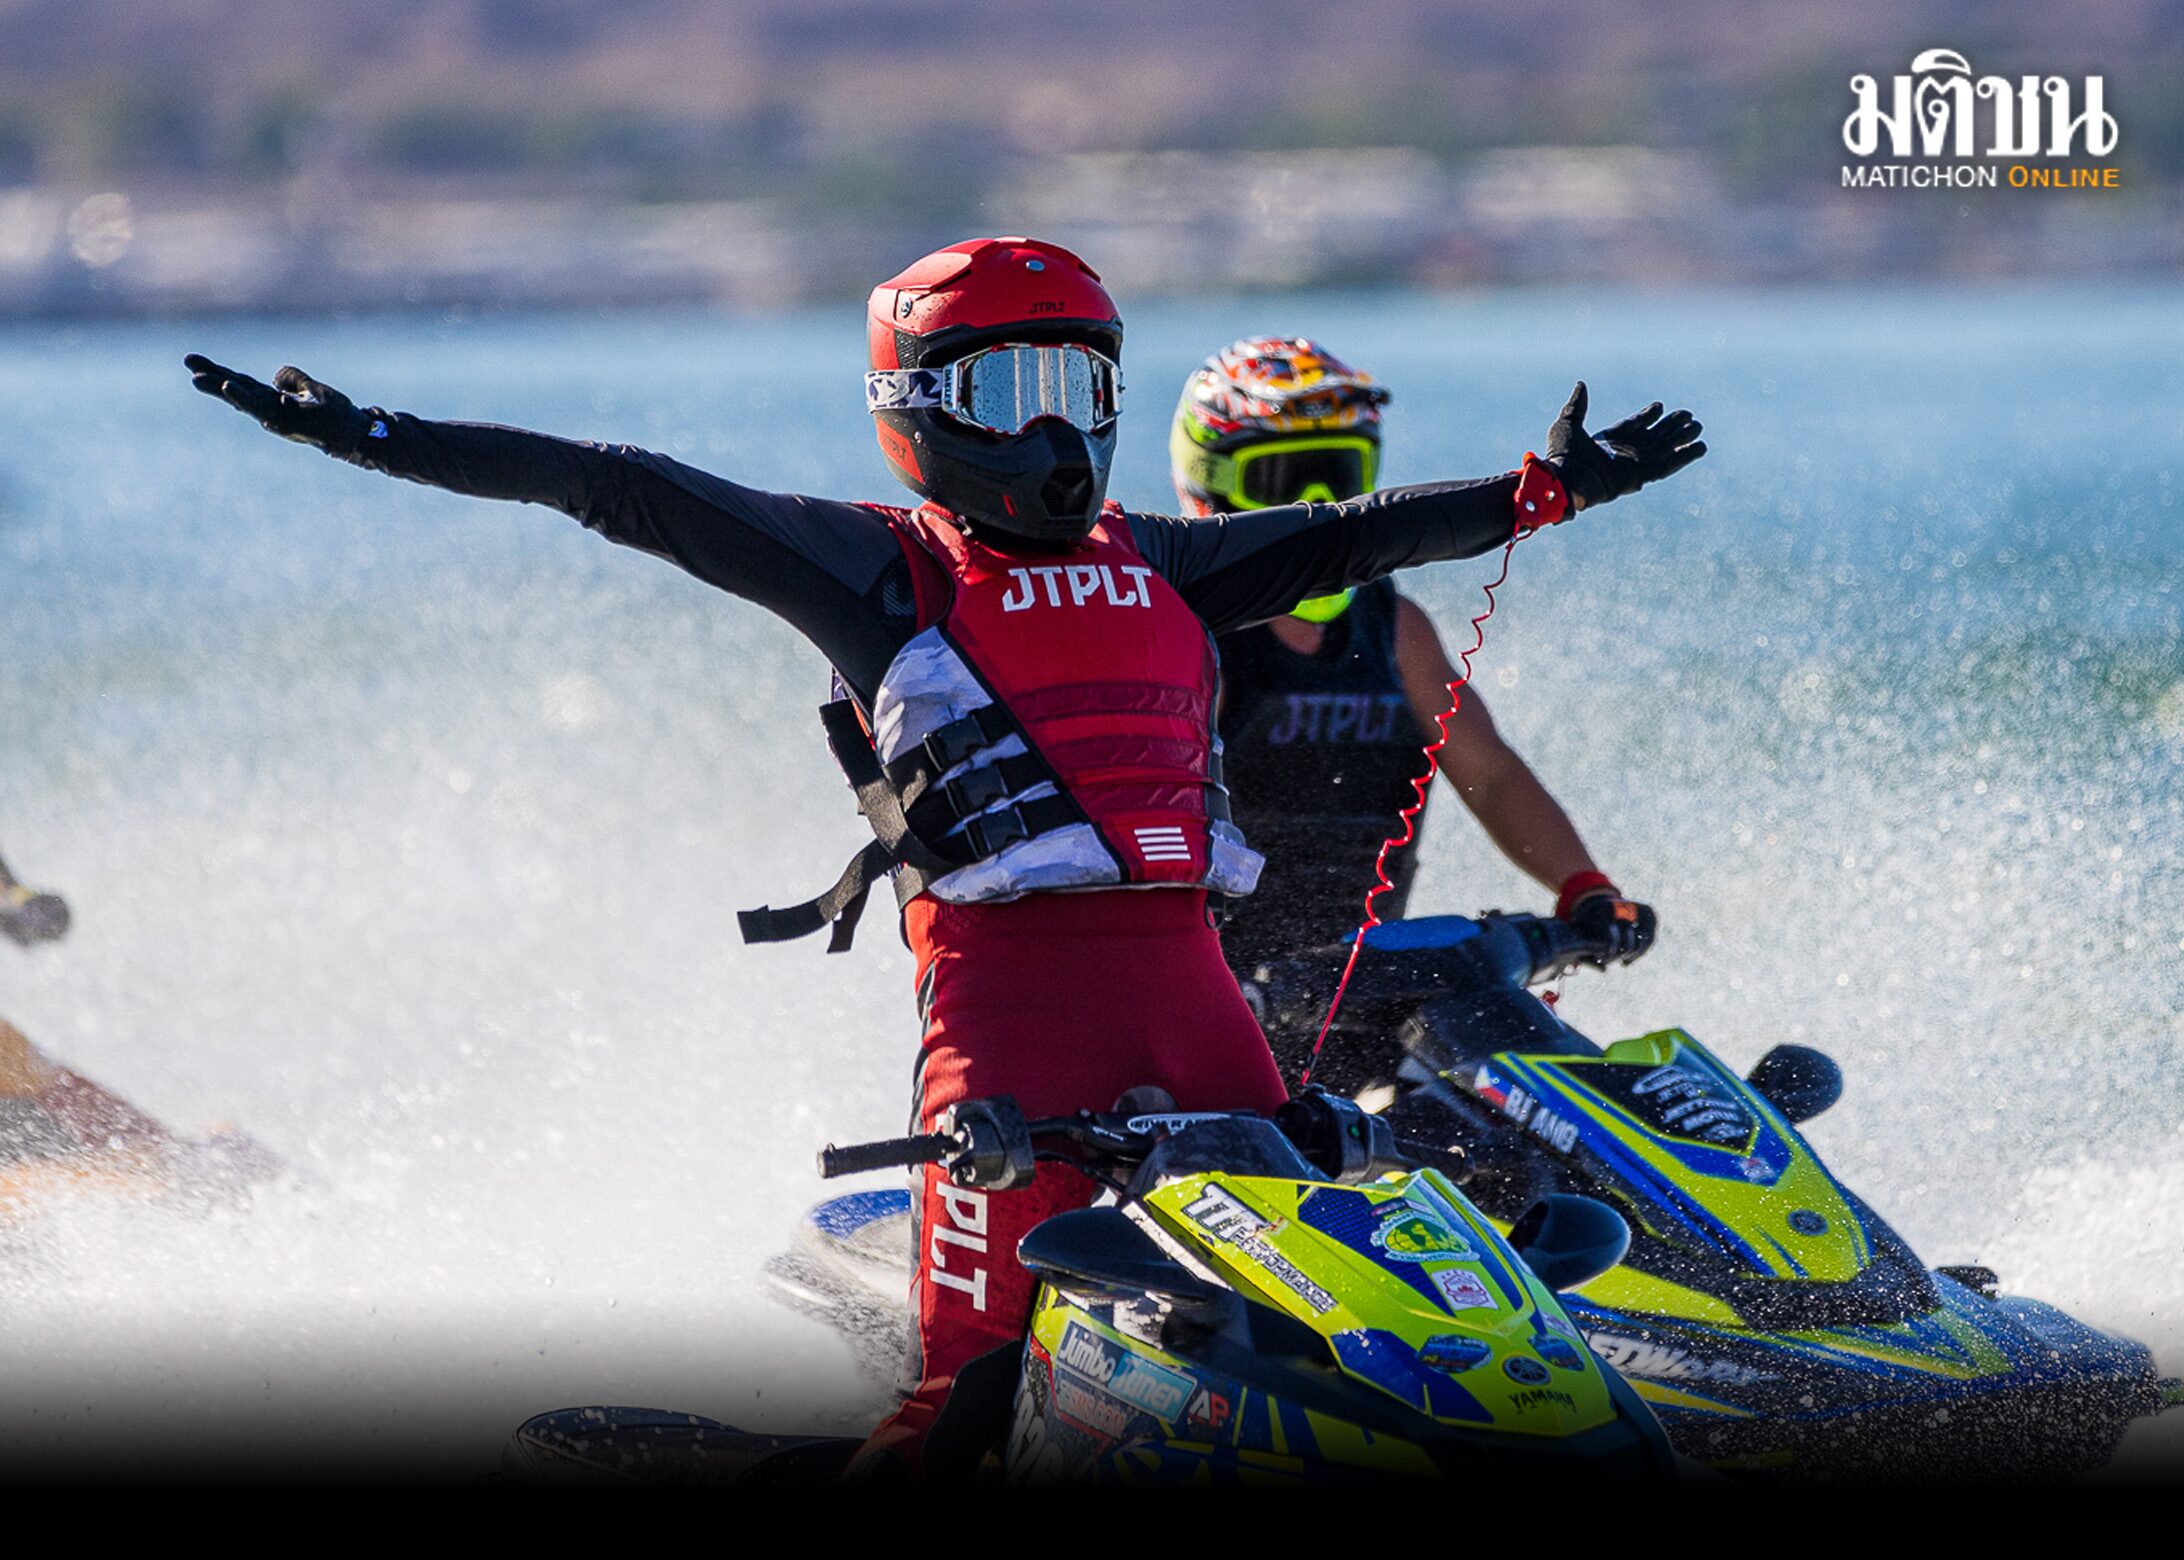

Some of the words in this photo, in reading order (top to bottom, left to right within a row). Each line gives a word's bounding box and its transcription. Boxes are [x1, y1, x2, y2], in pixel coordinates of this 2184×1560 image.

[1002, 564, 1152, 612] JTPLT
[1268, 694, 1404, 744] JTPLT
[930, 1113, 988, 1312] PLT
[1059, 1327, 1117, 1383] Jumbo
[1508, 1389, 1578, 1415] YAMAHA
